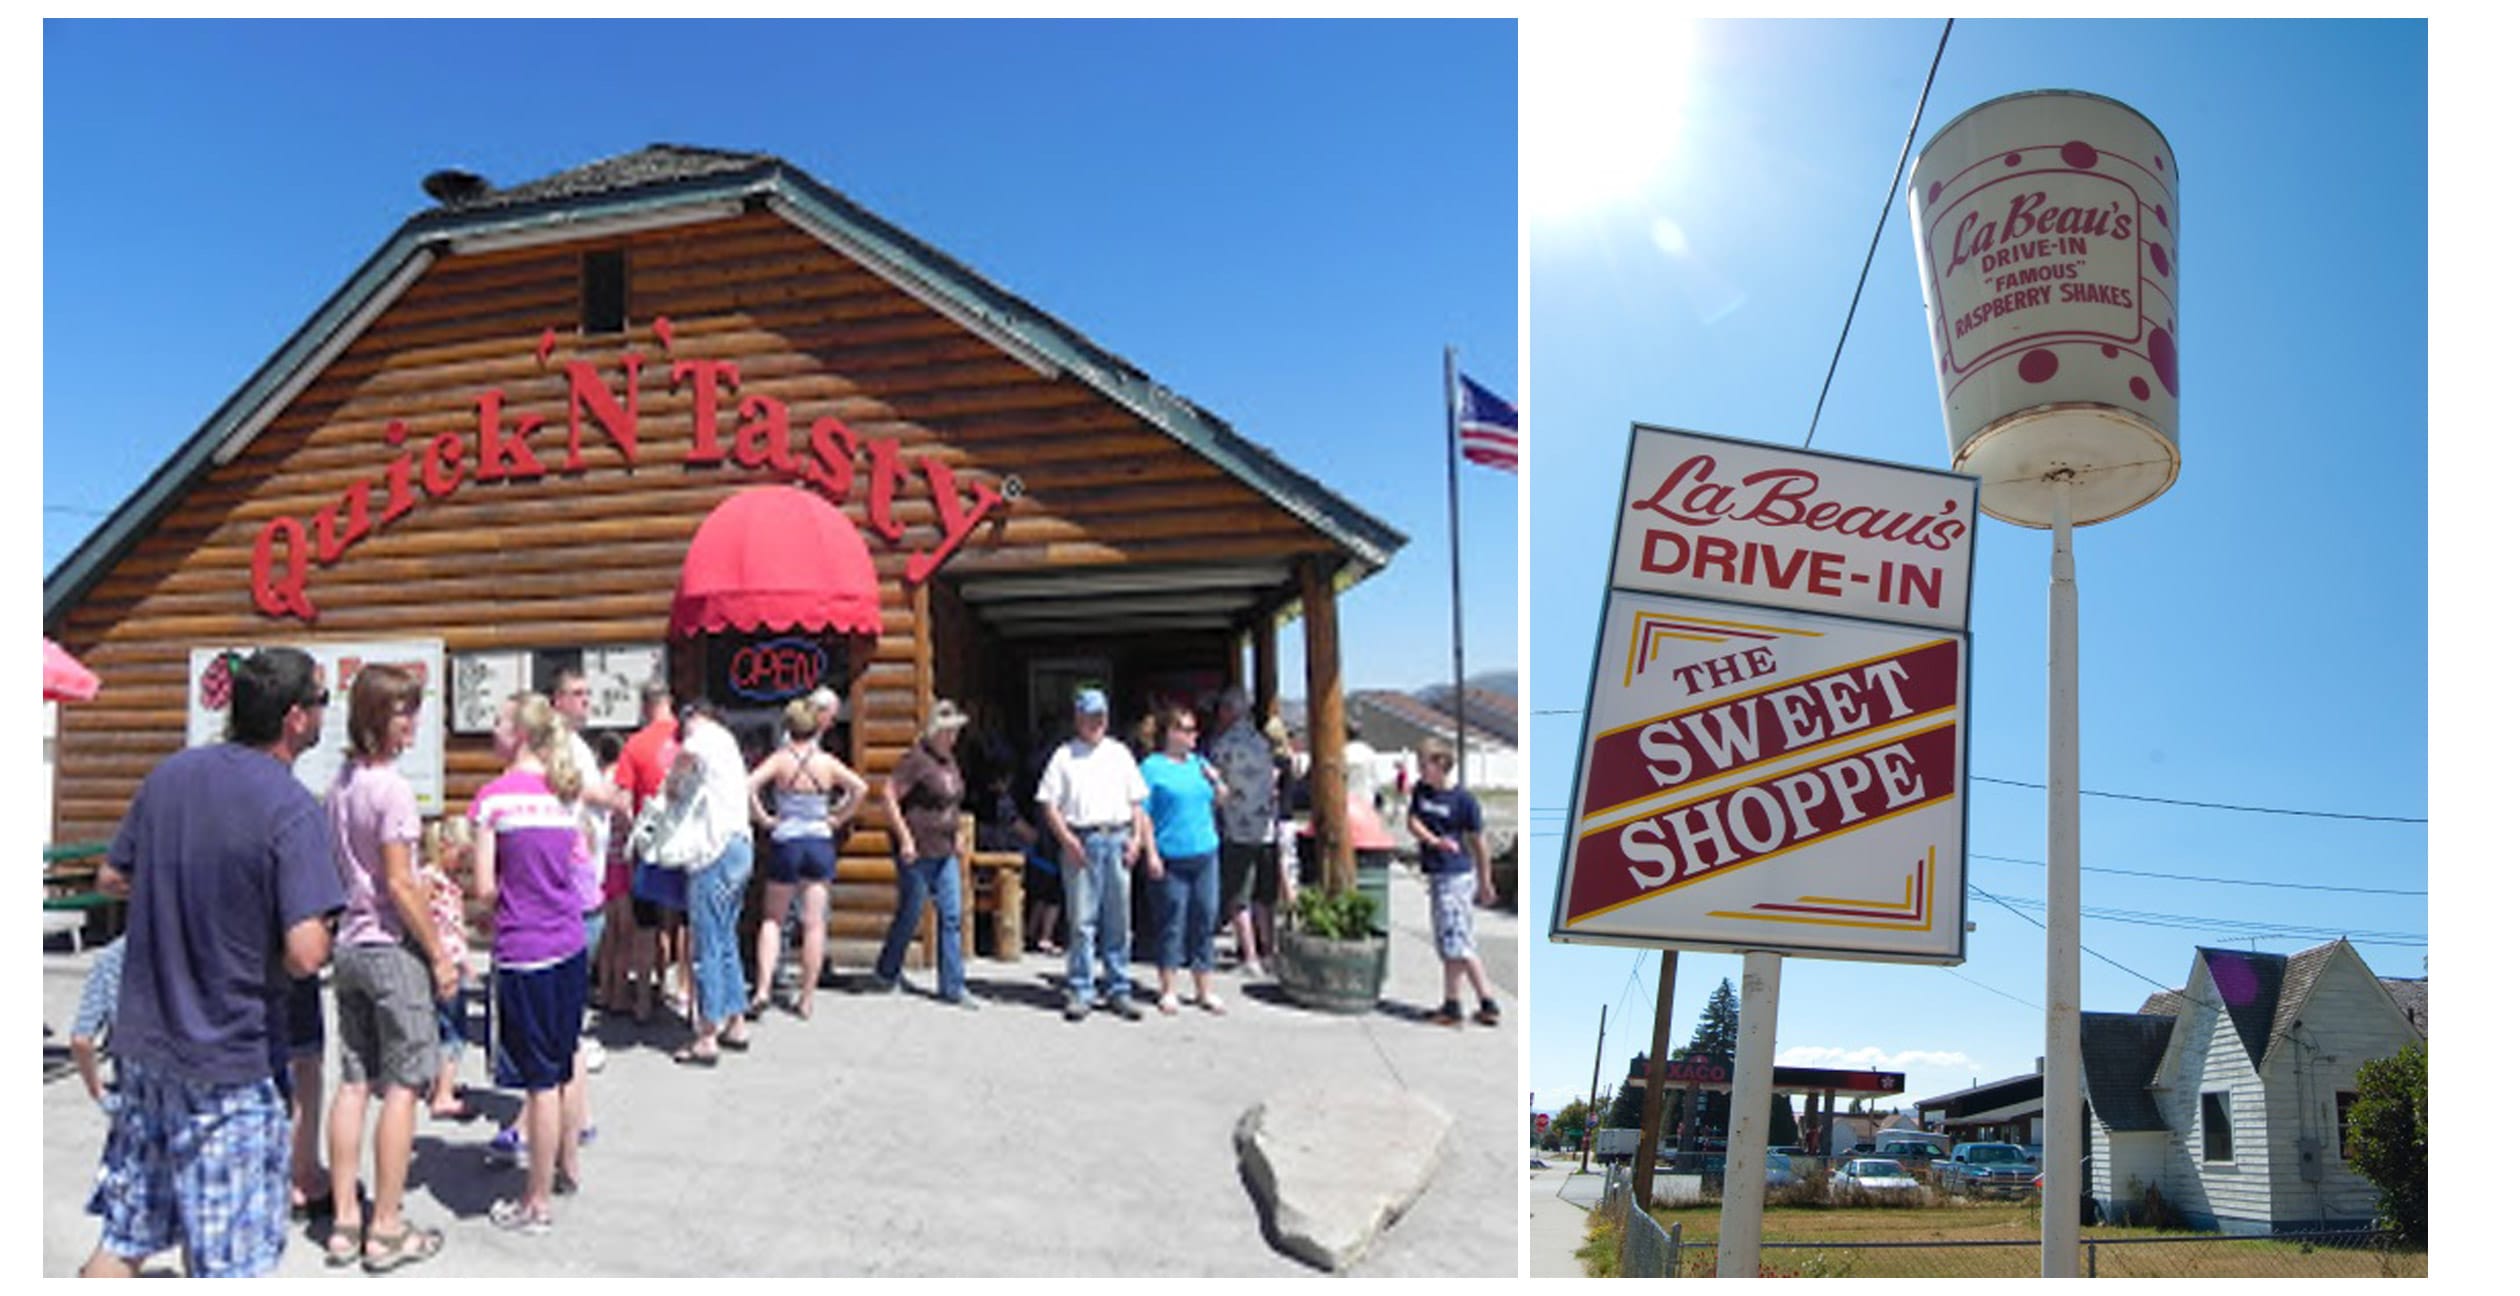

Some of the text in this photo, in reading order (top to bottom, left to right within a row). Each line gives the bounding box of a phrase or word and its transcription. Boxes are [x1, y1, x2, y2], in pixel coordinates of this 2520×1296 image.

[1981, 236, 2088, 274] DRIVE-IN
[1954, 282, 2134, 340] RASPBERRY SHAKES
[251, 389, 548, 619] Quick
[672, 360, 1003, 583] Tasty
[1639, 529, 1943, 609] DRIVE-IN
[729, 646, 819, 691] OPEN
[1672, 645, 1778, 696] THE
[1637, 660, 1914, 788] SWEET
[1618, 743, 1926, 891] SHOPPE
[1642, 1062, 1726, 1082] TXACO
